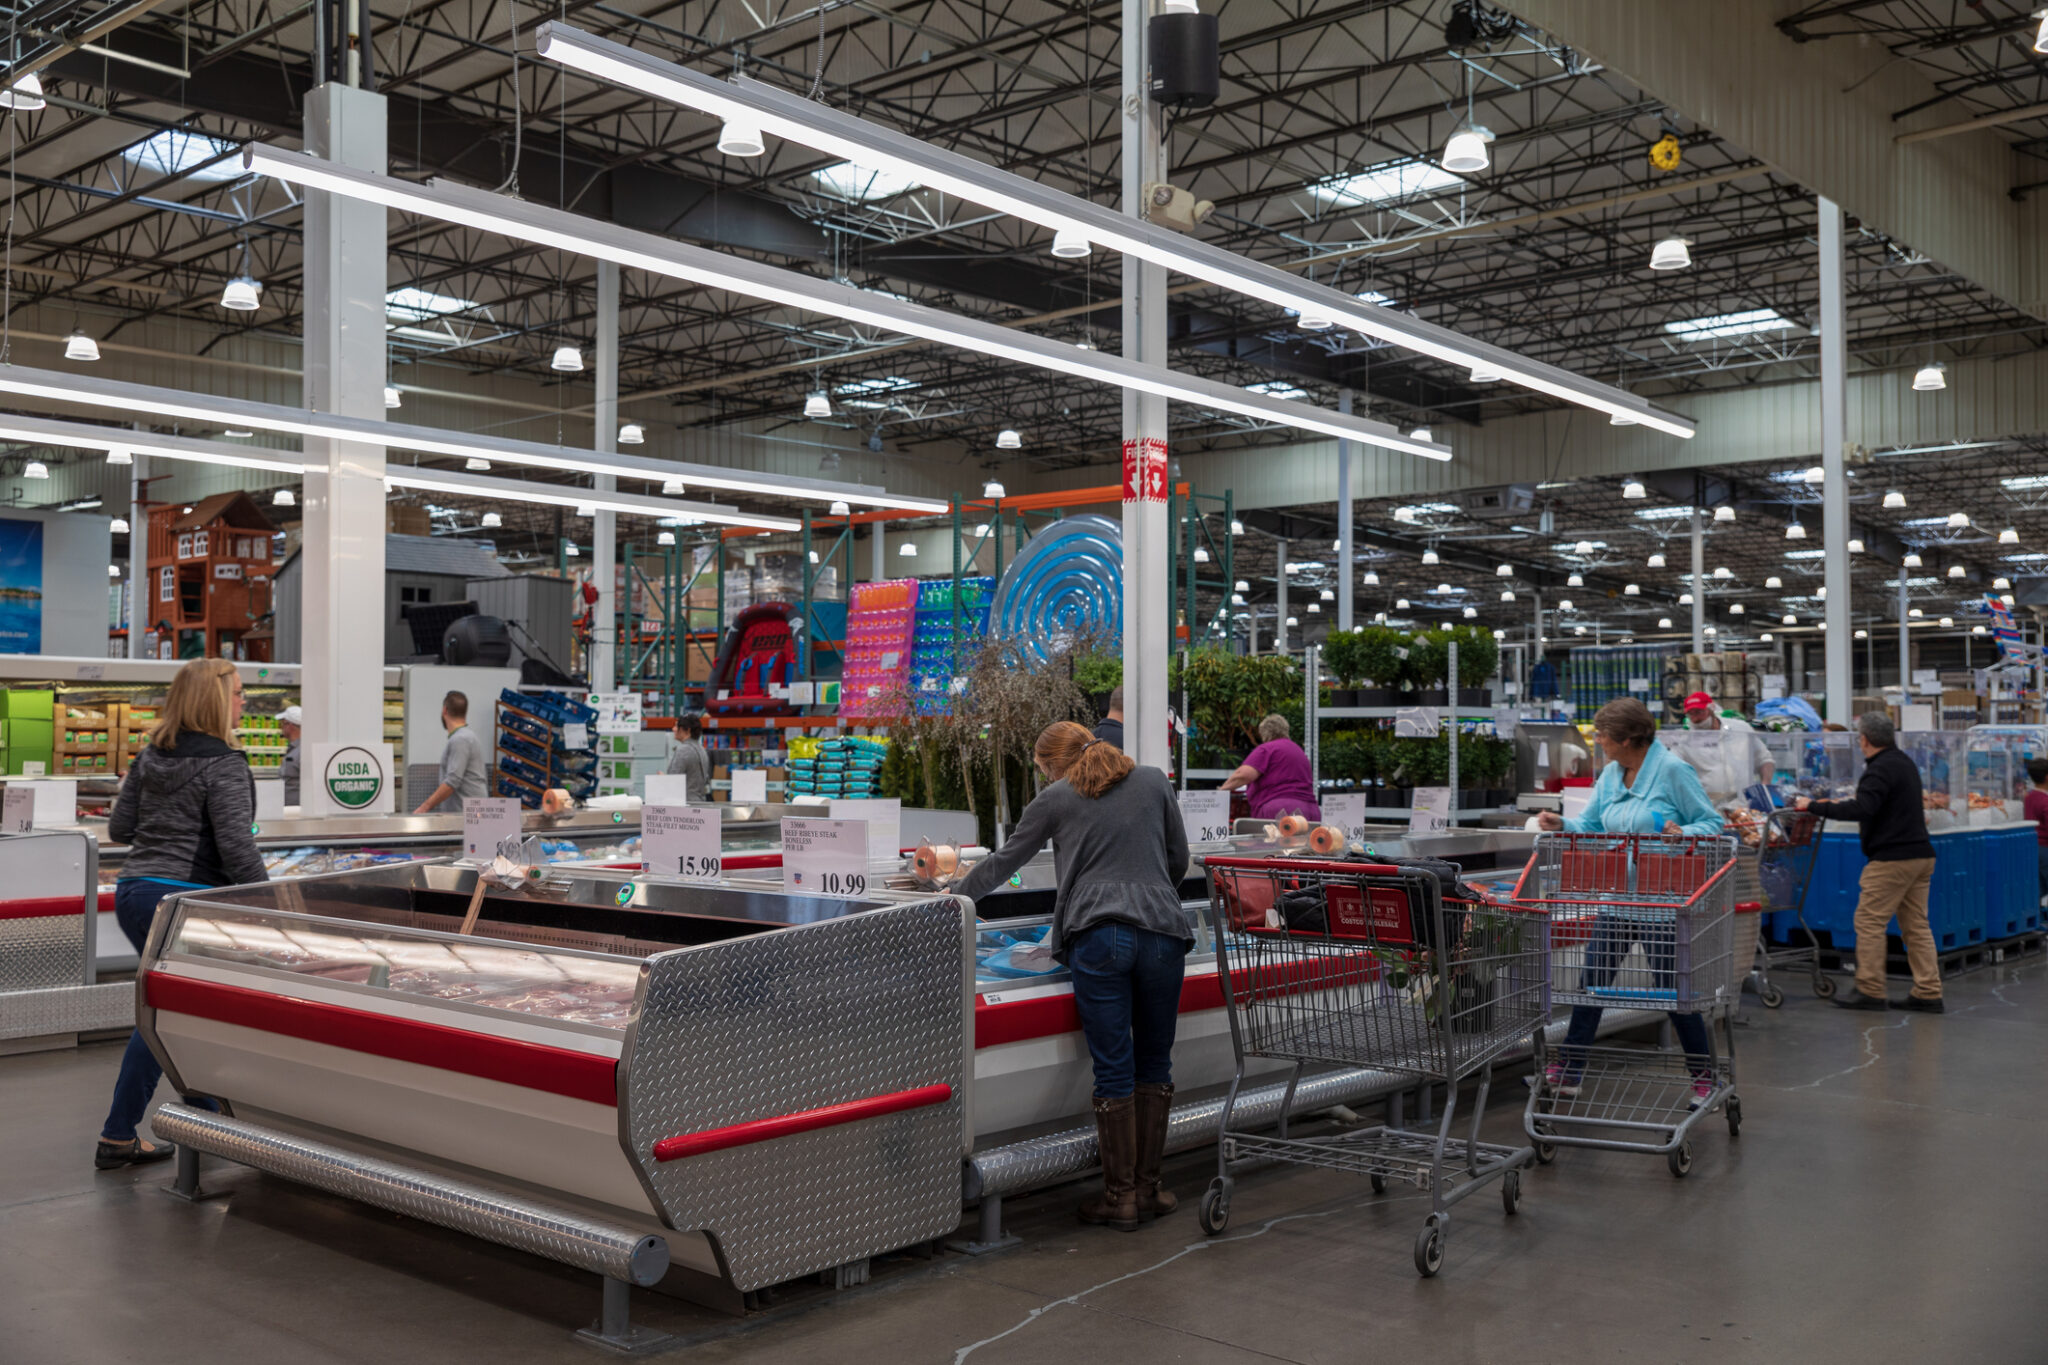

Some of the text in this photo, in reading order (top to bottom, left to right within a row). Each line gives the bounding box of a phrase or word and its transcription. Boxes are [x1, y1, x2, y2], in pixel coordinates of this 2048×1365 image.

[338, 762, 369, 776] USDA
[334, 780, 375, 793] ORGANIC
[673, 816, 705, 825] TENDERLOIN
[1430, 818, 1447, 831] 8.99
[785, 829, 838, 839] BEEF RIBEYE STEAK
[1200, 826, 1228, 841] 26.99
[785, 837, 812, 845] BONELESS
[678, 856, 720, 877] 15.99
[821, 872, 866, 896] 10.99
[1341, 917, 1399, 929] COSTCO OLESALE
